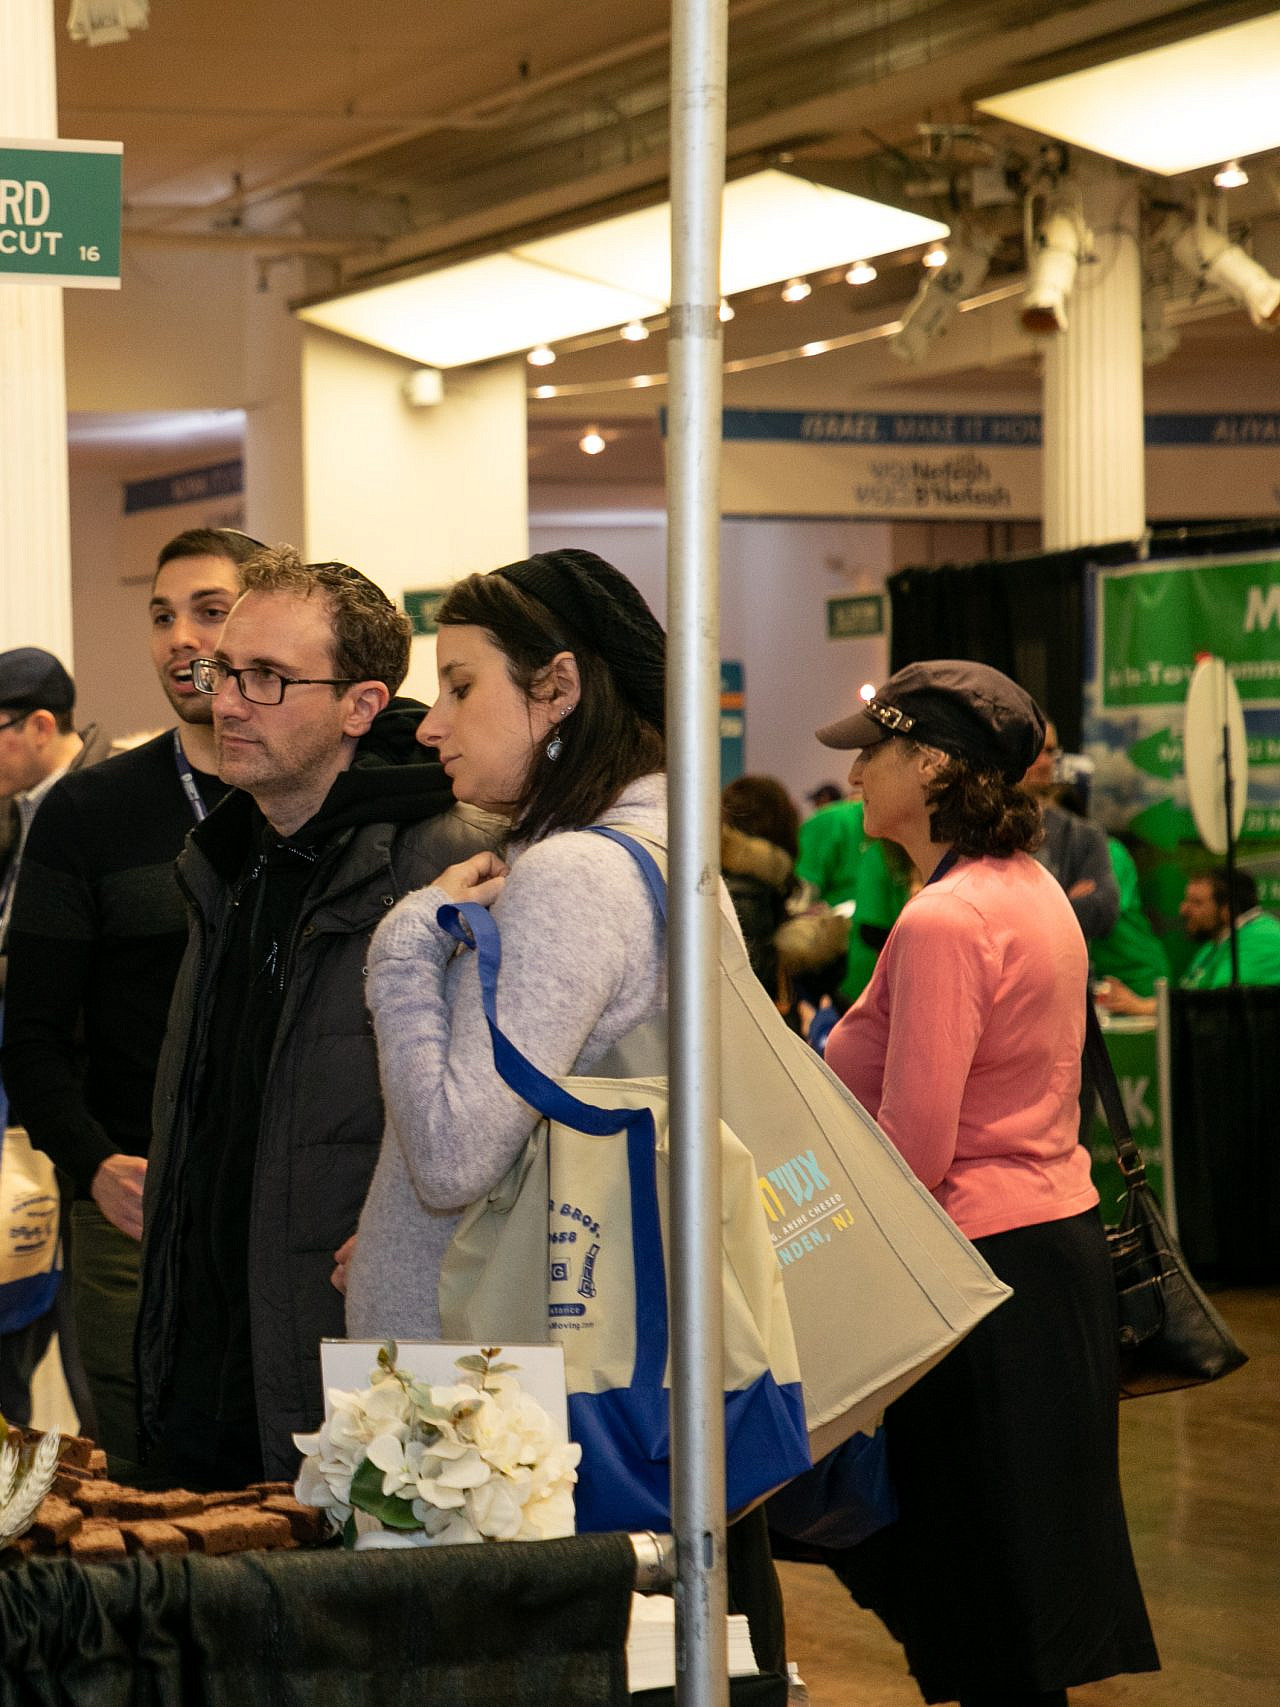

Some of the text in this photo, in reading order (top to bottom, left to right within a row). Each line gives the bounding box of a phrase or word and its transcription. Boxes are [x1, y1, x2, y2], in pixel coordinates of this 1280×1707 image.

[79, 246, 101, 262] 16
[560, 1203, 600, 1239] BROS.
[777, 1208, 855, 1270] NDEN, NJ
